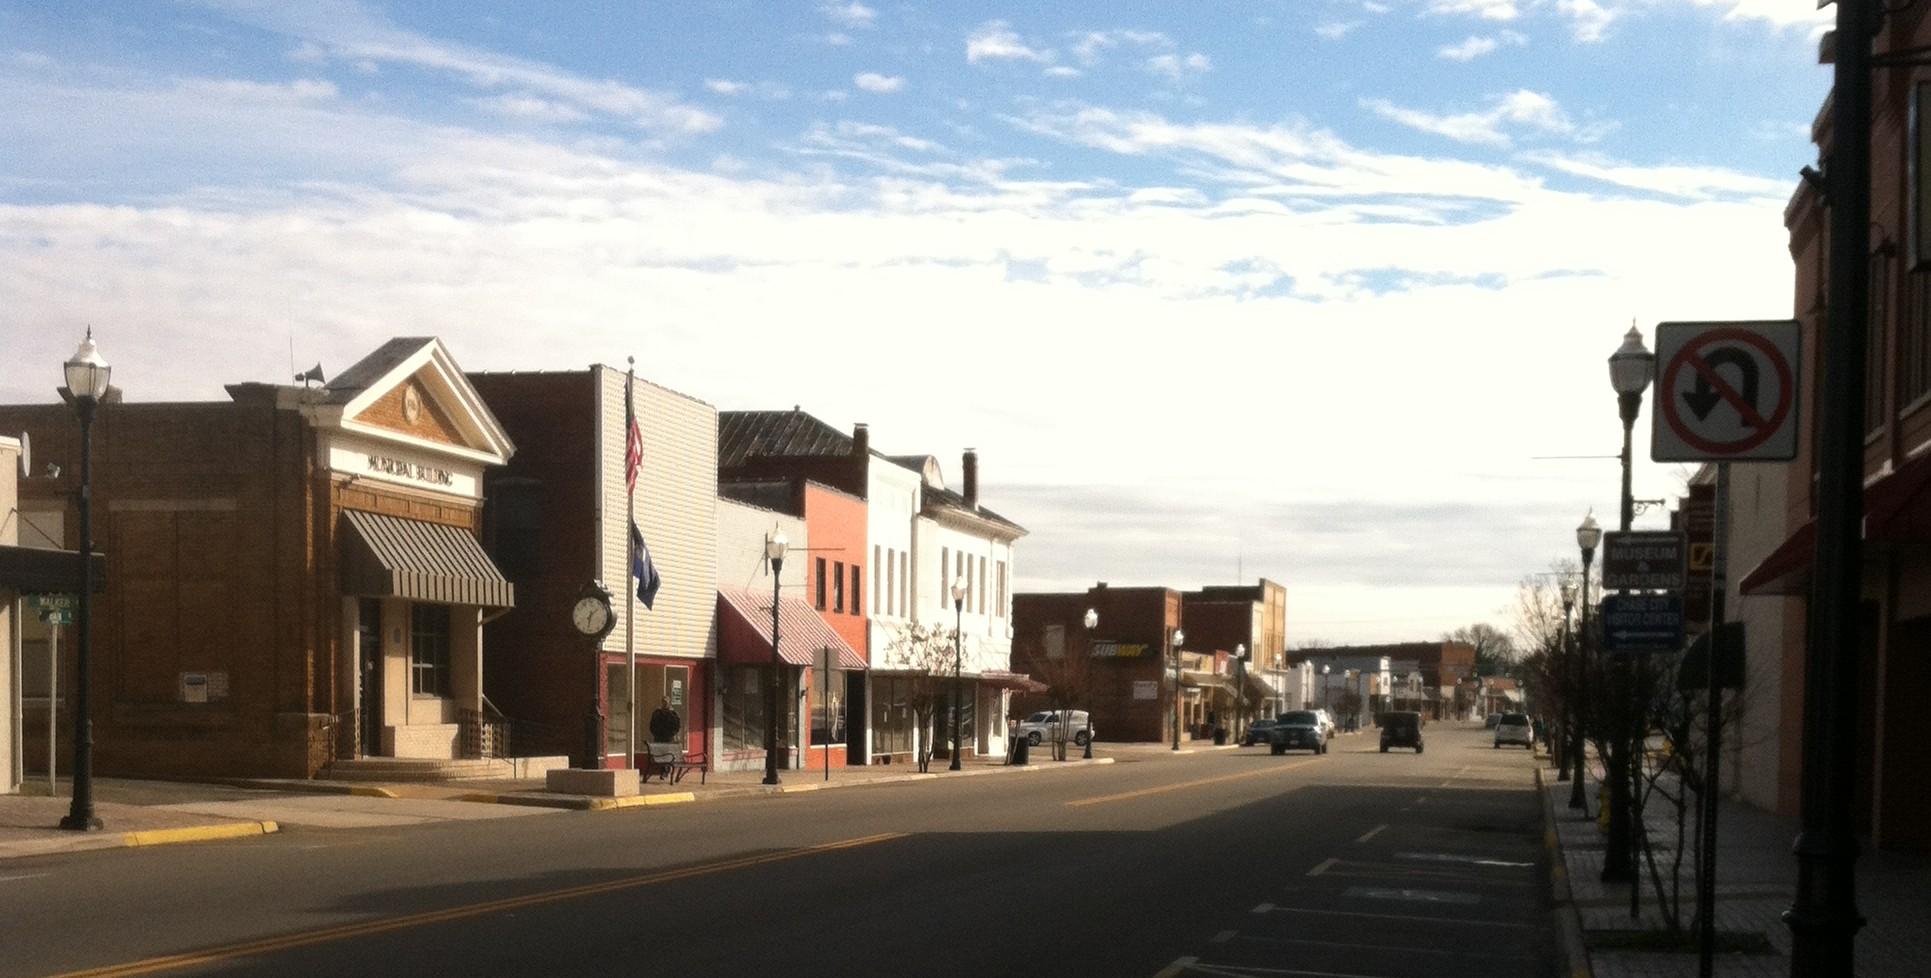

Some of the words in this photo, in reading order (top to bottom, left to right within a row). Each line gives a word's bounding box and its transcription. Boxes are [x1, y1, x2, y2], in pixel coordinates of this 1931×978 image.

[368, 455, 413, 478] MUNICIPAL
[416, 465, 453, 486] BUILDING
[1611, 547, 1677, 560] MUSEUM
[1607, 572, 1681, 585] GARDENS
[1649, 597, 1671, 611] CITY
[1092, 643, 1149, 656] SUBWAY
